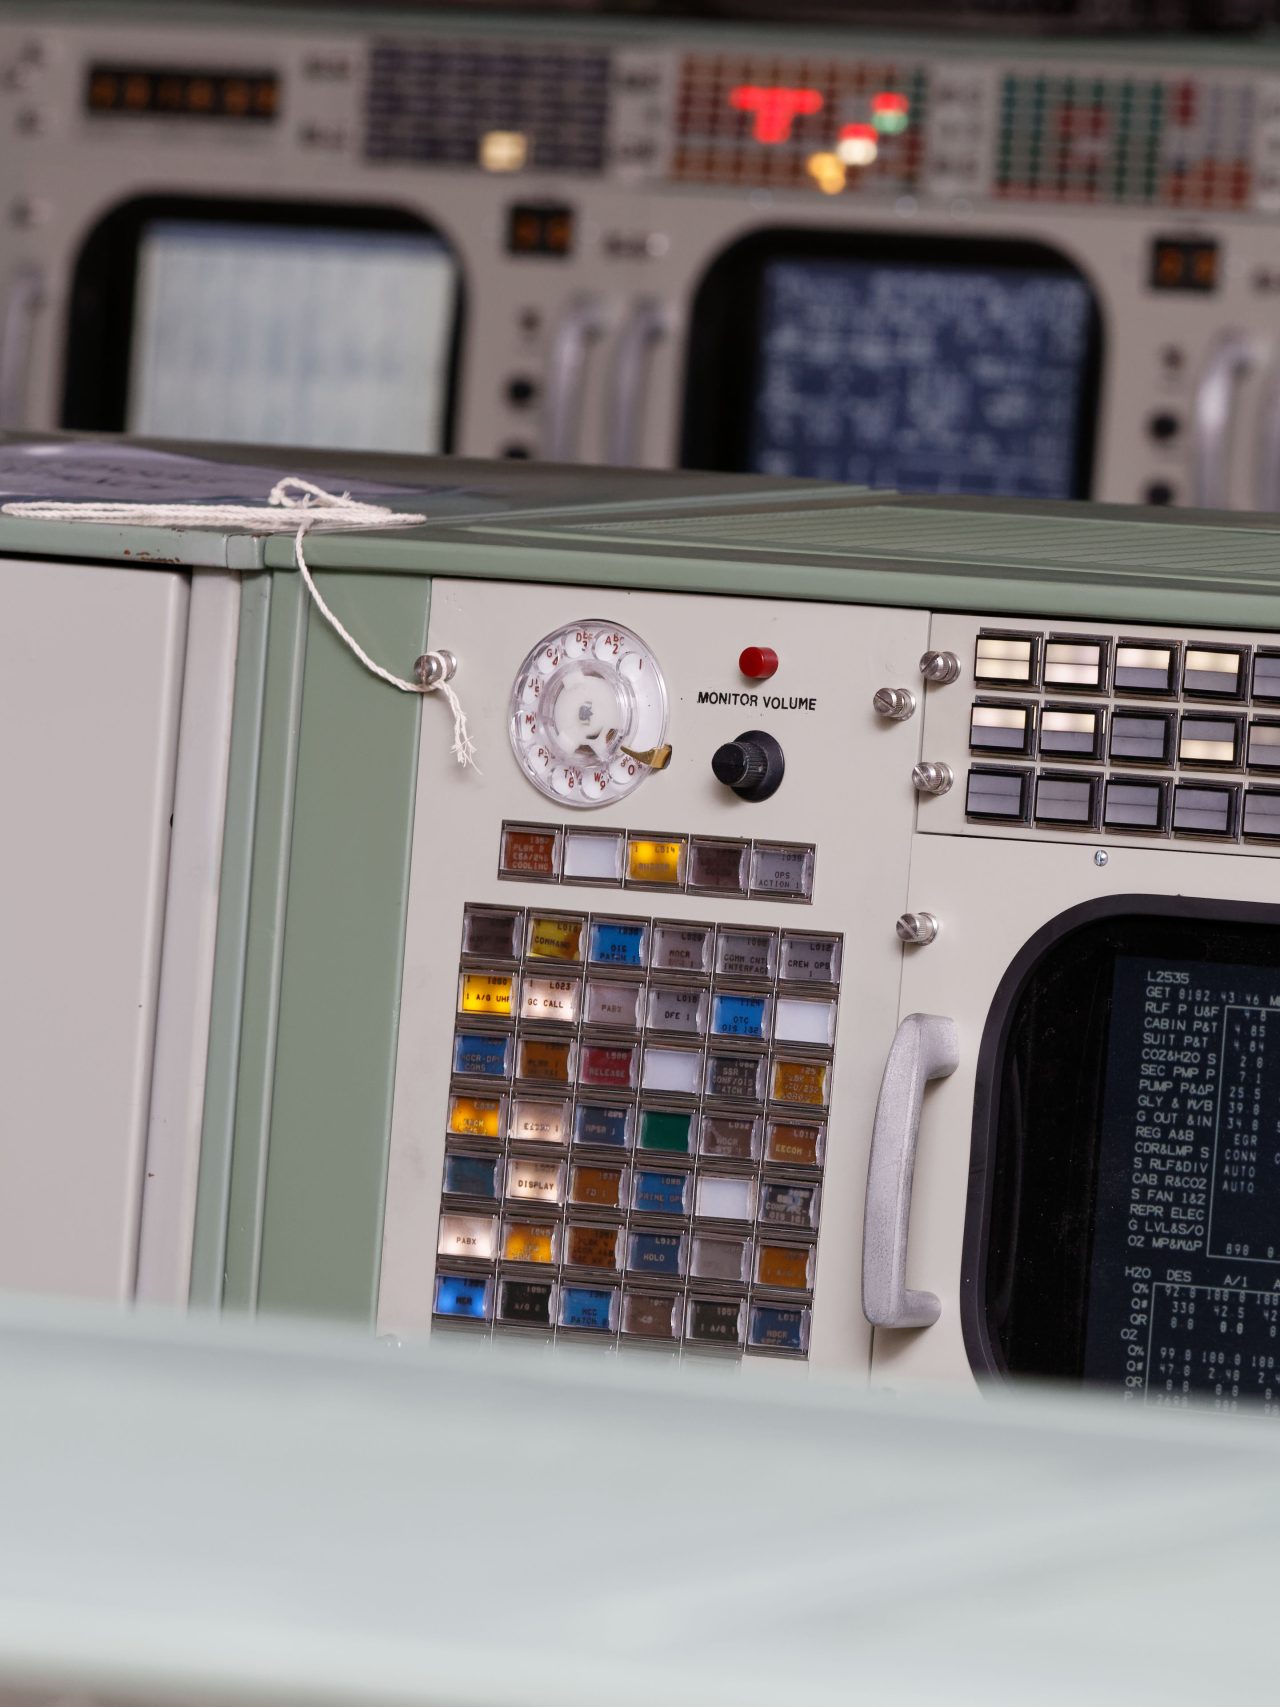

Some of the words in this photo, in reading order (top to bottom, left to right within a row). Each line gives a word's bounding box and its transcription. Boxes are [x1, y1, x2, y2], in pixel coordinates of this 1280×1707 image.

[697, 691, 758, 707] MONITOR
[763, 696, 817, 711] VOLUME
[774, 871, 790, 879] OPS
[758, 879, 790, 888] ACTION
[787, 959, 809, 968] CREW
[814, 961, 831, 970] OPS
[1147, 970, 1190, 985] L2535
[1145, 985, 1171, 999] GET
[543, 1000, 564, 1009] CALL
[1144, 1000, 1171, 1014] RLF
[664, 1011, 681, 1020] DFE
[1143, 1016, 1187, 1031] CABIN
[1192, 1020, 1218, 1033] P&T
[1142, 1032, 1176, 1046] SUIT
[1183, 1035, 1209, 1048] P&T
[588, 1068, 625, 1078] RELEASE
[1140, 1063, 1166, 1077] SEC
[1172, 1065, 1200, 1079] PMP
[1138, 1078, 1174, 1092] PUMP
[1137, 1094, 1164, 1108] GLY
[1187, 1098, 1214, 1112] W/B
[1153, 1111, 1178, 1125] OUT
[1135, 1125, 1162, 1139] REG
[1167, 1128, 1195, 1142] A&B
[1233, 1133, 1258, 1147] EGR
[1134, 1141, 1194, 1157] CDR&LMP
[1149, 1157, 1209, 1174] RLF&DIV
[518, 1180, 554, 1190] DISPLAY
[1132, 1172, 1158, 1186] CAB
[1147, 1188, 1174, 1203] FAN
[1129, 1203, 1164, 1217] REPR
[1170, 1206, 1205, 1221] ELEC
[456, 1237, 477, 1245] PABX
[643, 1253, 665, 1262] HOLD
[1124, 1266, 1152, 1280] H2O
[1166, 1268, 1192, 1283] DES
[1223, 1274, 1248, 1288] A/1
